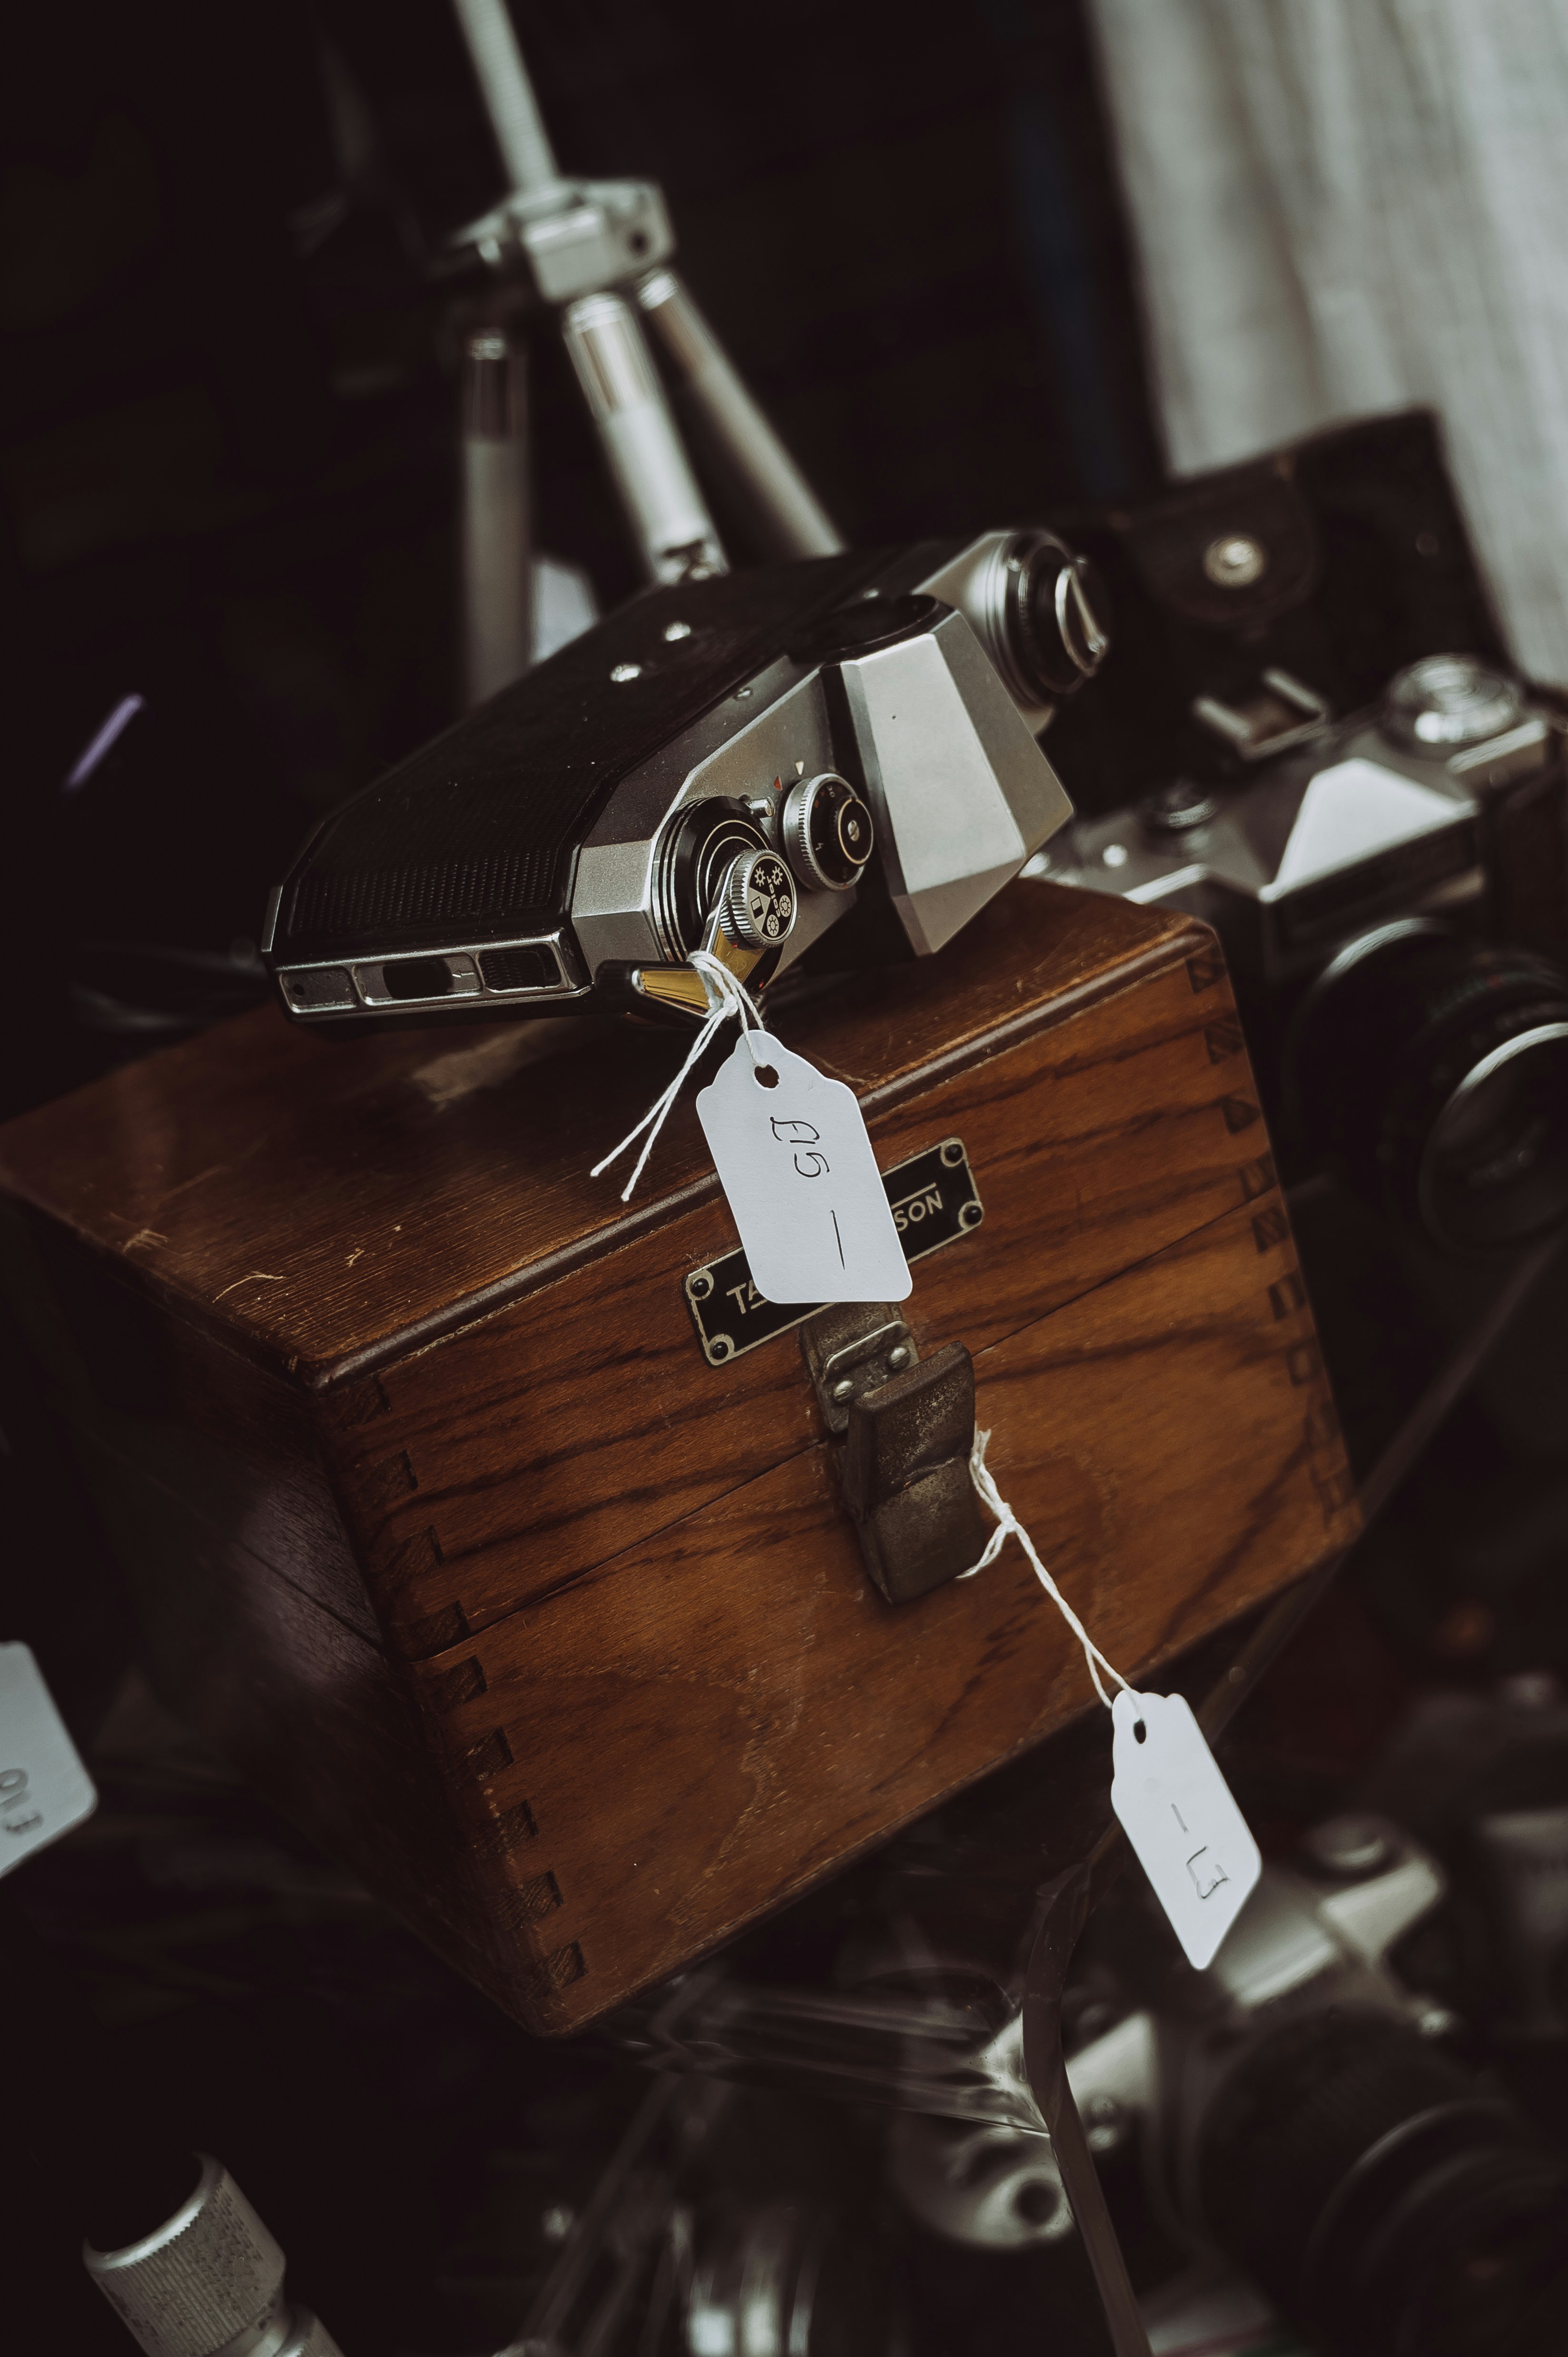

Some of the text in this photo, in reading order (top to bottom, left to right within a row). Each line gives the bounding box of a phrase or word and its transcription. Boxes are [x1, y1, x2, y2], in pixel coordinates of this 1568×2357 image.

[770, 1116, 830, 1178] £15
[726, 1190, 943, 1314] TA SON
